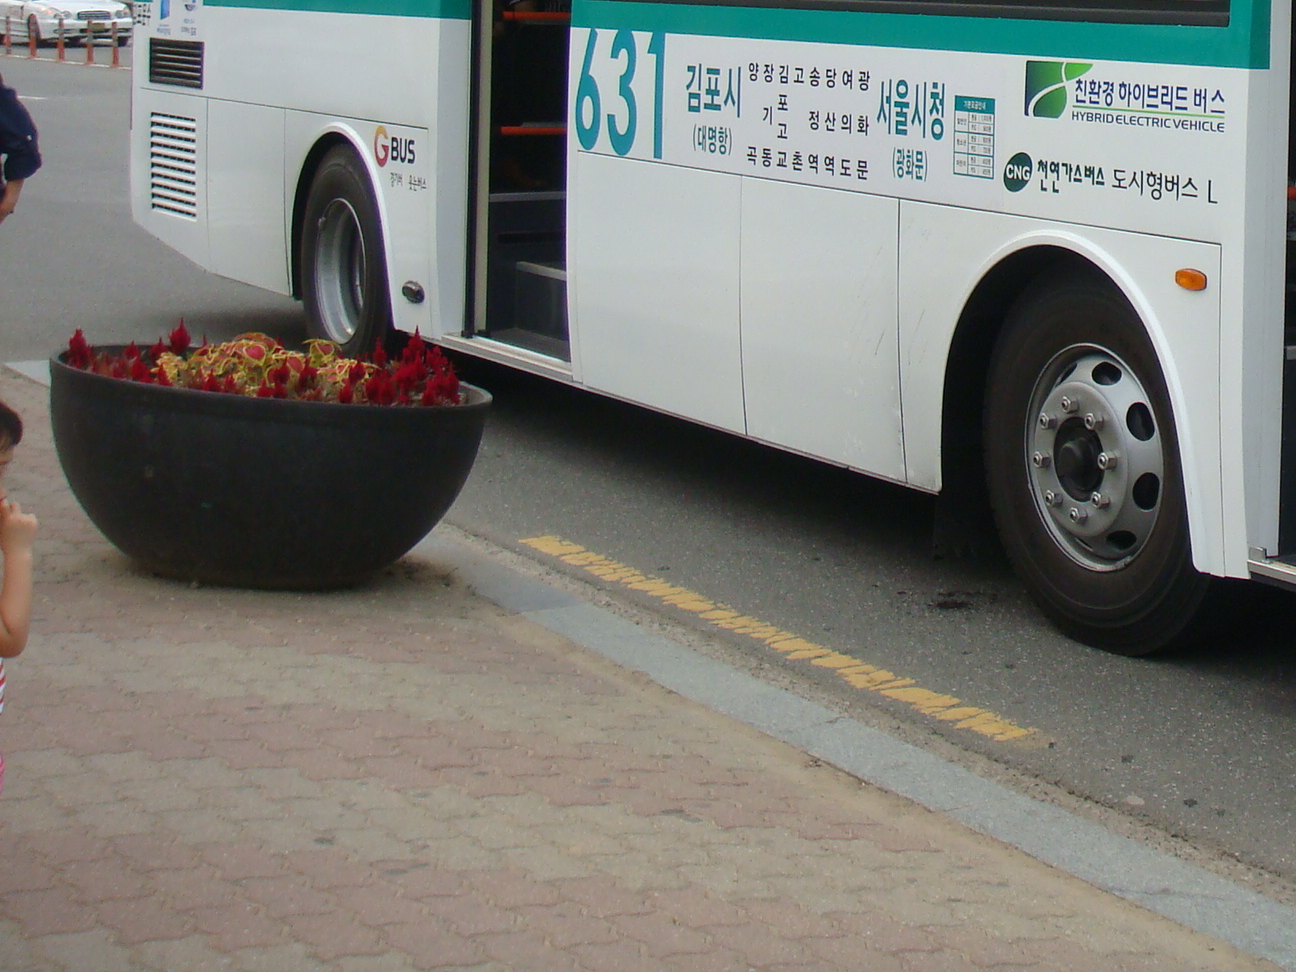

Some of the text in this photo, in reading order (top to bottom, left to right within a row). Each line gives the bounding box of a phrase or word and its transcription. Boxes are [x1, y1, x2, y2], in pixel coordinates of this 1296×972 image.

[575, 28, 666, 160] 631
[686, 63, 741, 118] 김포시
[876, 79, 945, 141] 서울시청
[1075, 78, 1225, 114] 친환경 하이브리드 버스
[693, 123, 732, 157] (대명항)
[1072, 111, 1225, 133] HYBRID ELECTRIC VEHICLE
[892, 146, 928, 182] (광화문)
[1006, 163, 1031, 181] CNG
[1037, 159, 1105, 194] 천연가스버스
[1111, 168, 1198, 201] 도시형버스
